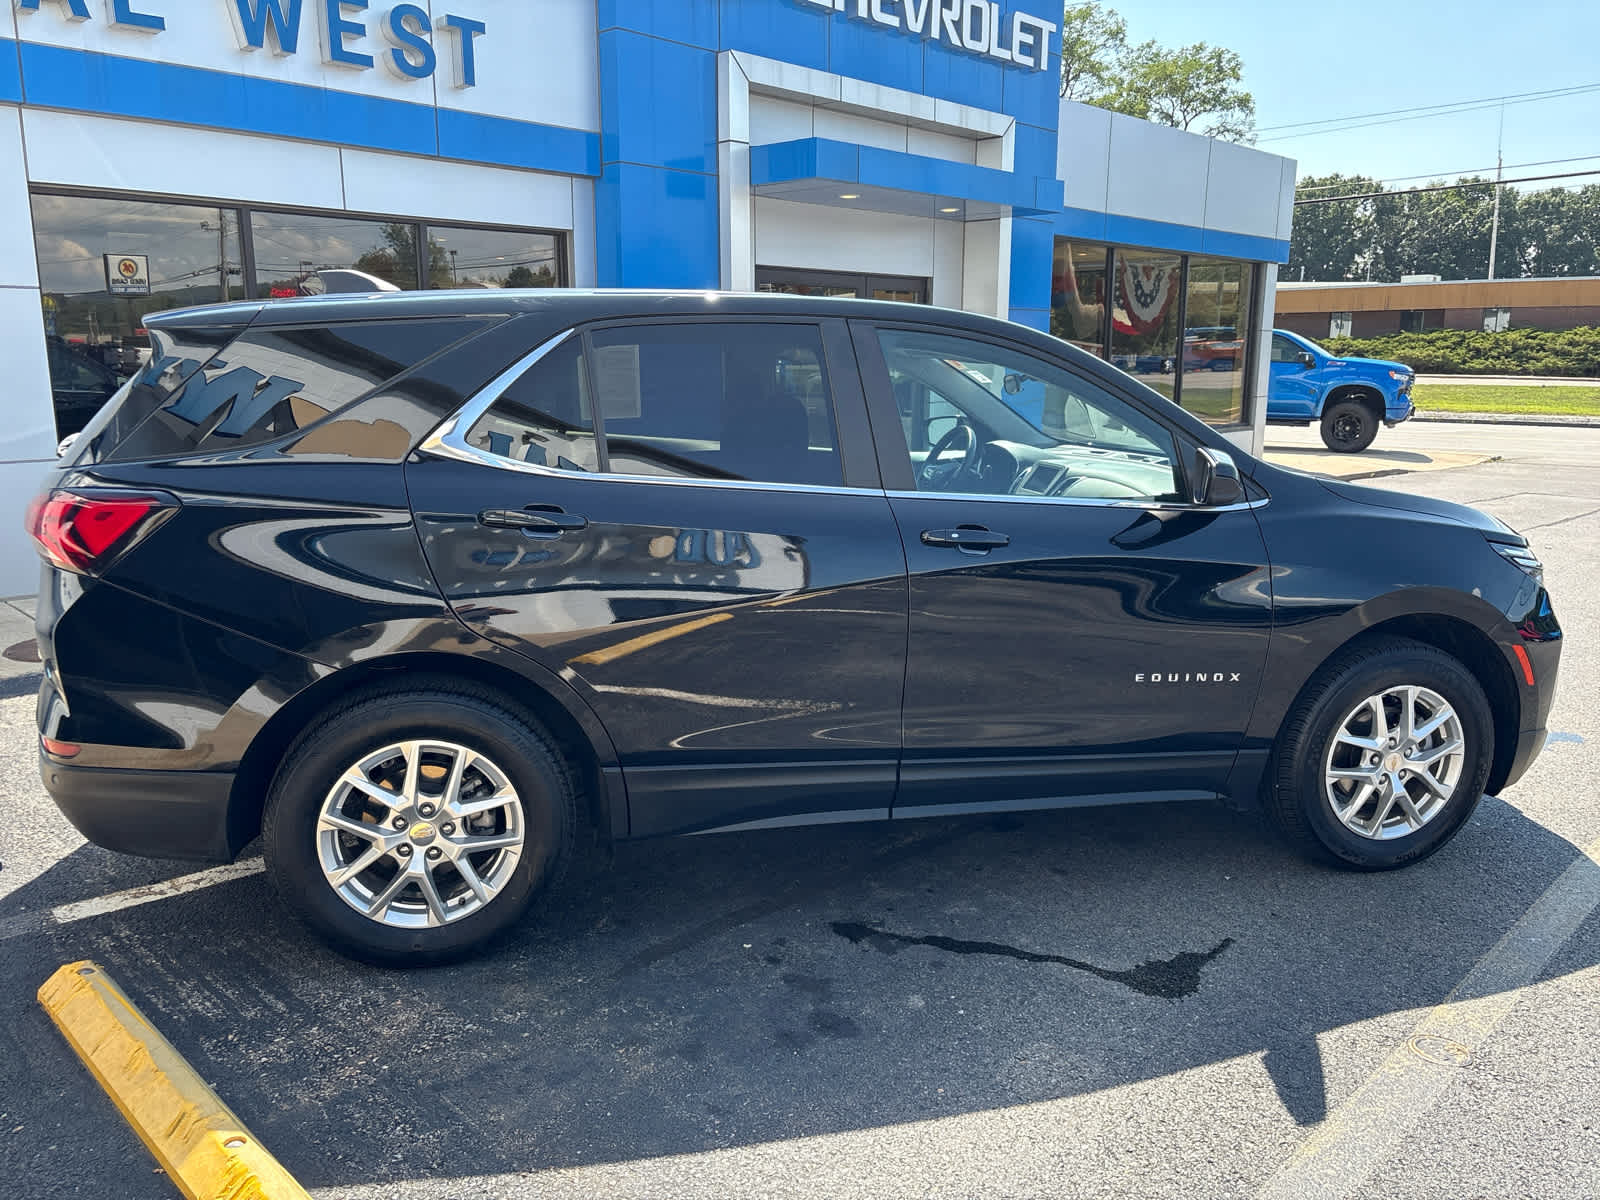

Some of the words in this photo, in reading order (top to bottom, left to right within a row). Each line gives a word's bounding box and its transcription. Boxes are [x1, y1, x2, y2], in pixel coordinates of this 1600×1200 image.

[230, 0, 486, 88] WEST
[806, 0, 1057, 72] VROLET
[1135, 672, 1241, 682] EQUINOX
